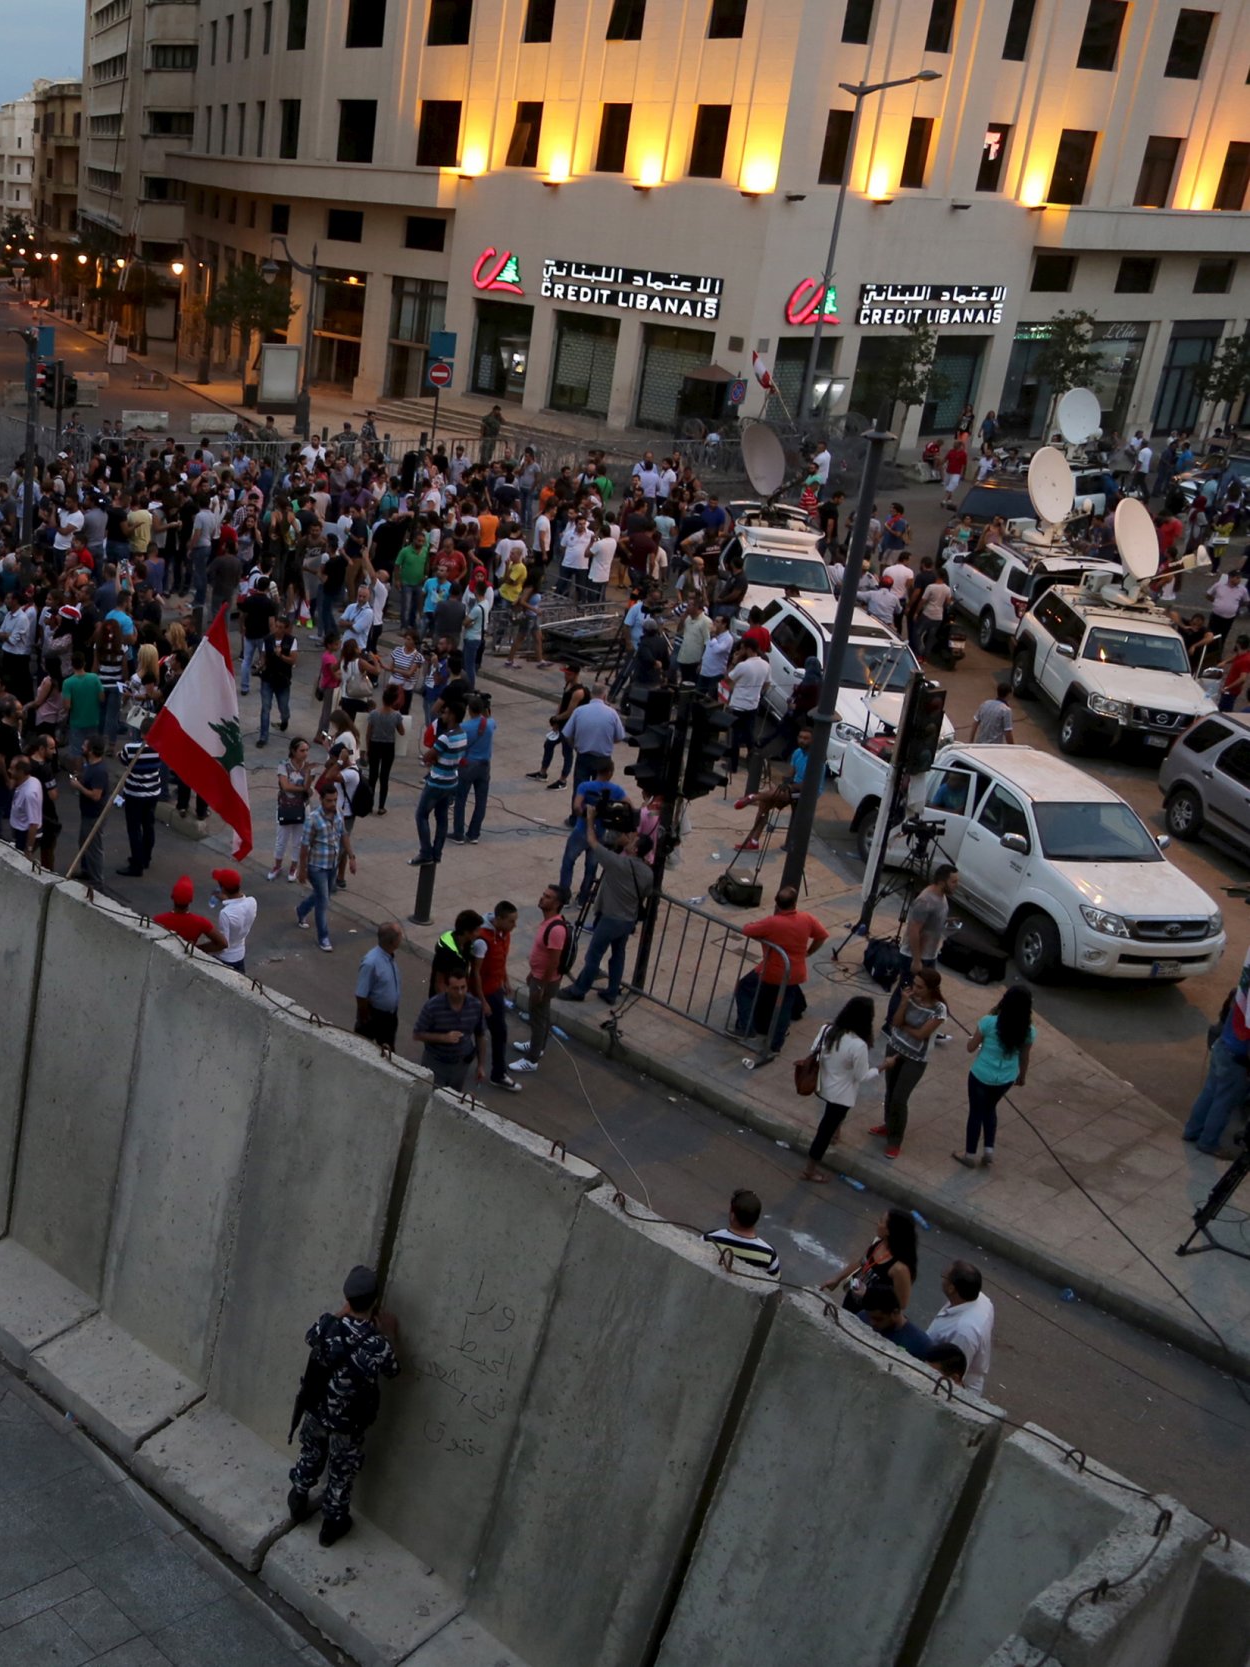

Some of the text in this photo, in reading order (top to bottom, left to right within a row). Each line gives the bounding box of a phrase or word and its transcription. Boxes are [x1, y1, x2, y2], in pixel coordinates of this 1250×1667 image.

[540, 282, 718, 319] CREDIT LIBANAIS
[859, 308, 1003, 325] CREDIT LIBANAIS
